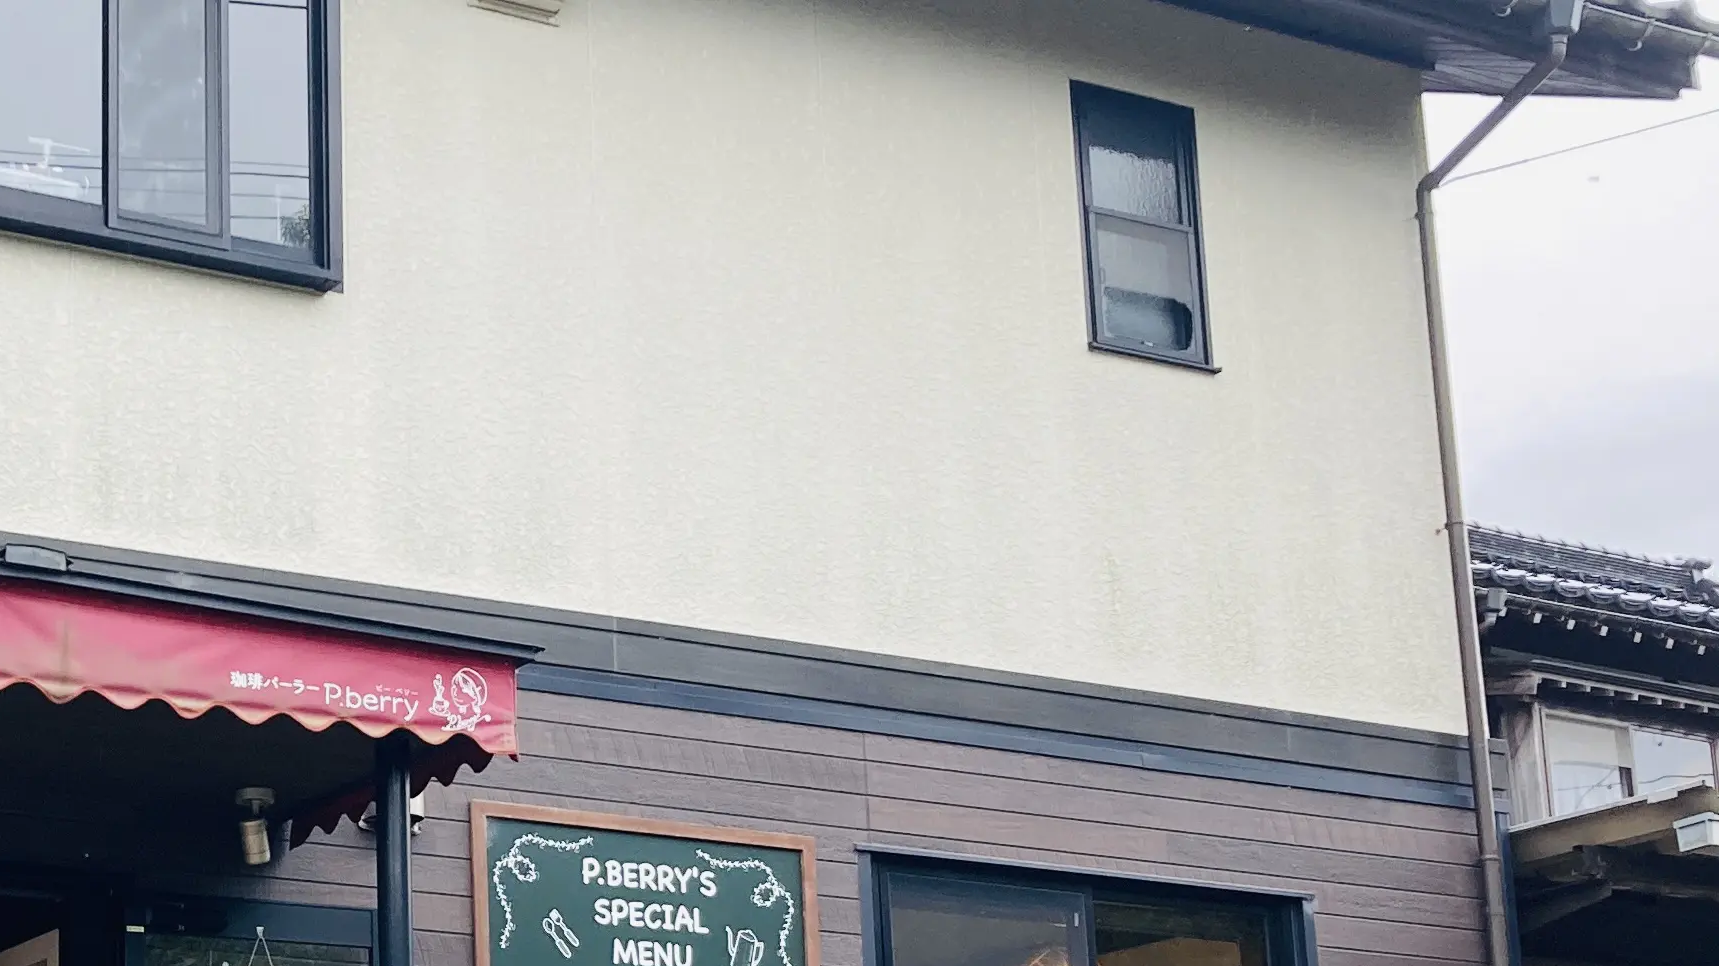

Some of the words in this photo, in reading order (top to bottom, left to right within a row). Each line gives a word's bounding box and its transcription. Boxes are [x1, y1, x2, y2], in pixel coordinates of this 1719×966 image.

[230, 671, 320, 694] 珈琲パーラー
[323, 682, 419, 721] P.berry
[582, 857, 717, 897] P.BERRY'S
[594, 899, 710, 934] SPECIAL
